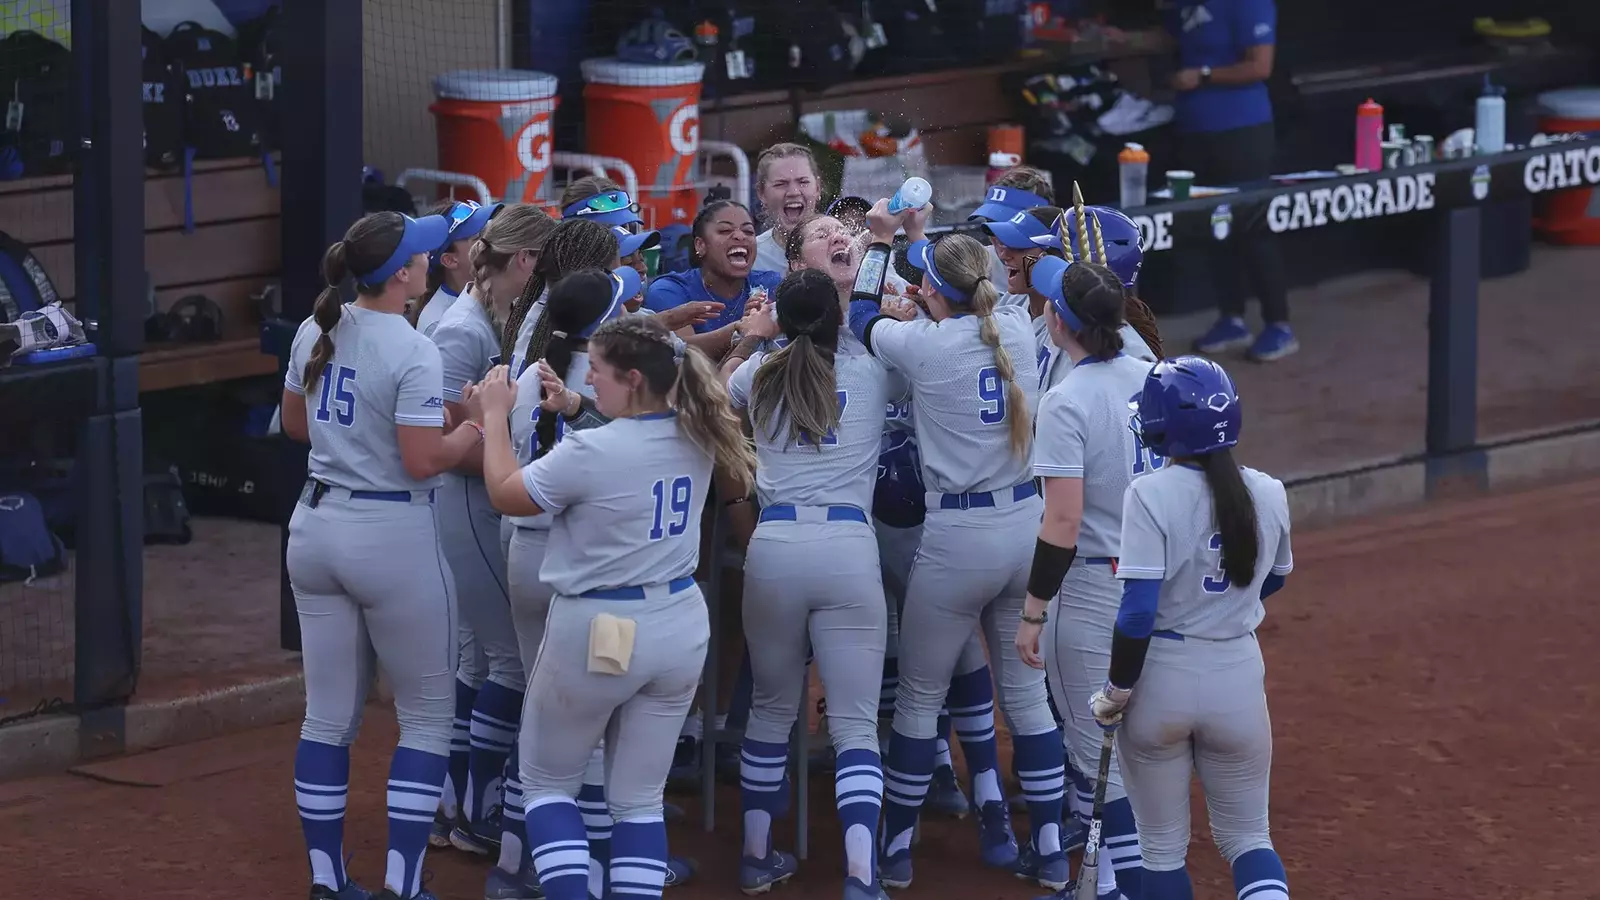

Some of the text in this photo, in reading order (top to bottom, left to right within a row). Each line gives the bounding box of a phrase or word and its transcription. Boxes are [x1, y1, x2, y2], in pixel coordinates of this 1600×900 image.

[186, 66, 242, 88] DUKE
[517, 119, 551, 173] G
[669, 103, 699, 156] G
[990, 188, 1007, 202] D
[1010, 211, 1026, 224] D
[1266, 172, 1436, 234] GATORADE
[315, 362, 357, 428] 15
[977, 366, 1006, 425] 9
[1218, 431, 1225, 443] 3
[647, 475, 693, 542] 19
[1202, 531, 1232, 594] 3
